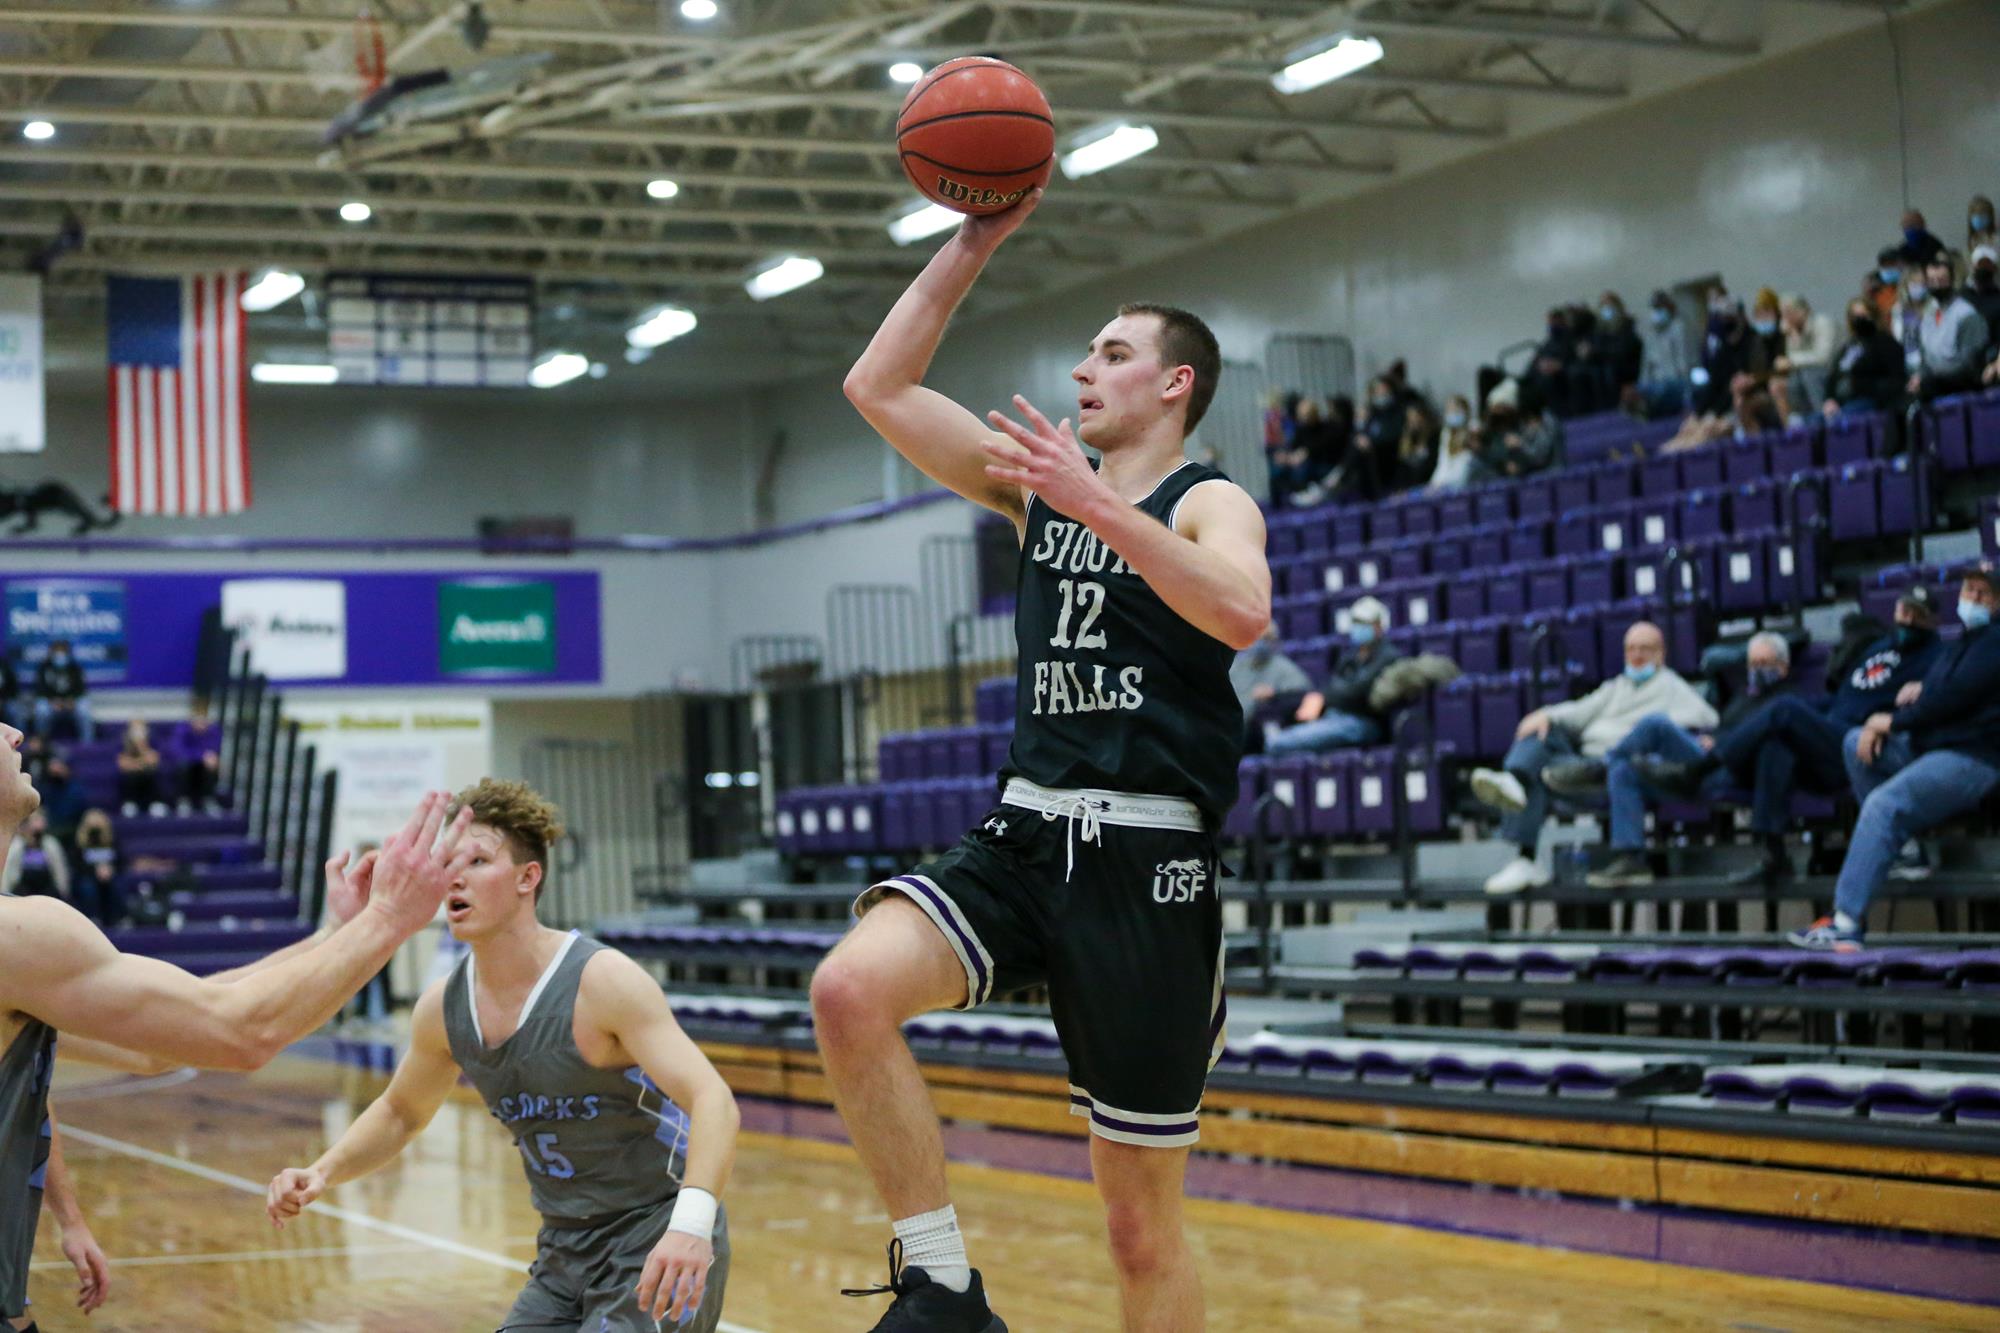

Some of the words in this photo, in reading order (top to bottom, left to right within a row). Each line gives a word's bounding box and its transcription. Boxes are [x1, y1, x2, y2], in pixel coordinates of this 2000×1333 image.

[1050, 578, 1108, 650] 12
[1032, 660, 1144, 715] FALLS
[1153, 874, 1207, 903] USF
[491, 1091, 601, 1122] COCKS
[518, 1131, 576, 1179] 15
